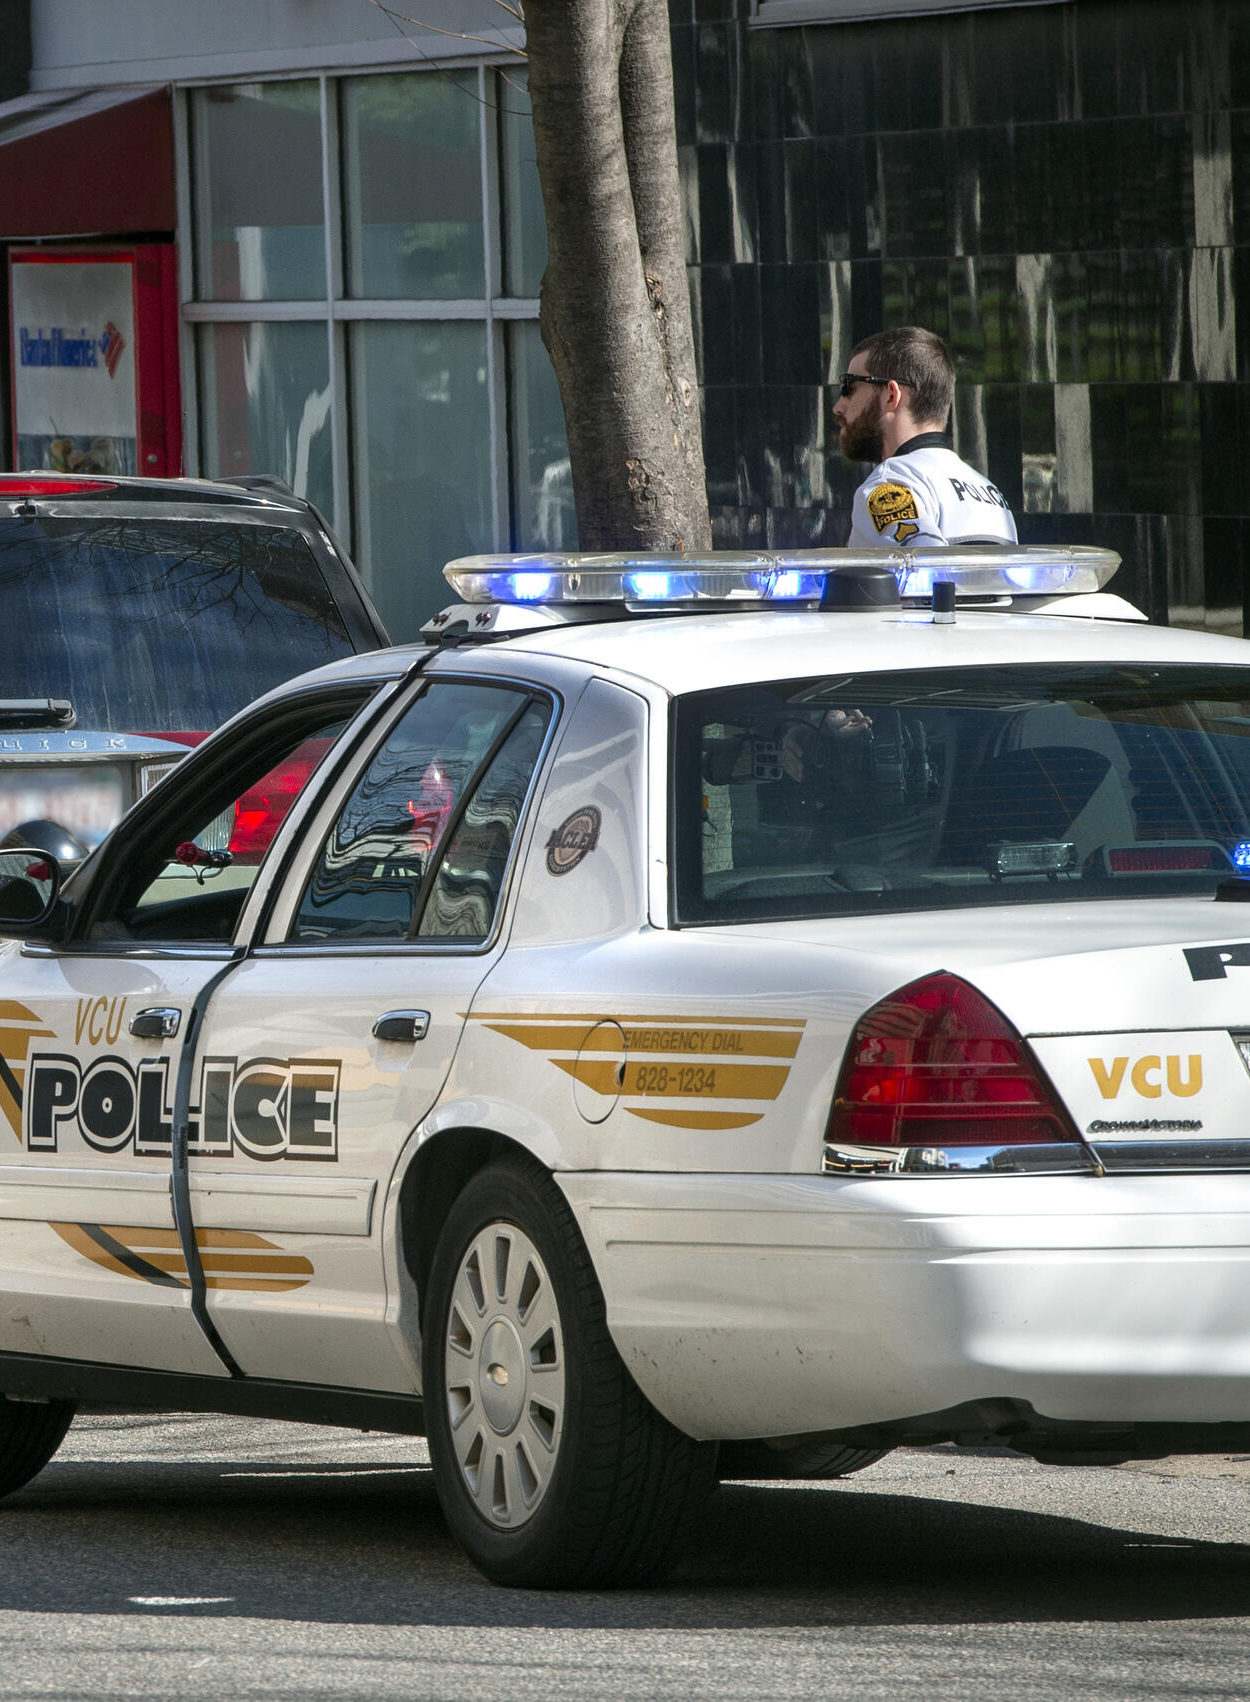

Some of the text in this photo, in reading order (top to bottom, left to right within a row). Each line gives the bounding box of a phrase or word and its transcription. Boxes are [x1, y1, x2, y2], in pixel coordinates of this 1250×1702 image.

[877, 510, 916, 529] POLICE
[74, 996, 128, 1046] VCU
[623, 1030, 745, 1051] EMERGENCY DIAL
[636, 1066, 716, 1093] 828-1234
[1087, 1054, 1203, 1100] VCU
[27, 1053, 343, 1163] POLICE
